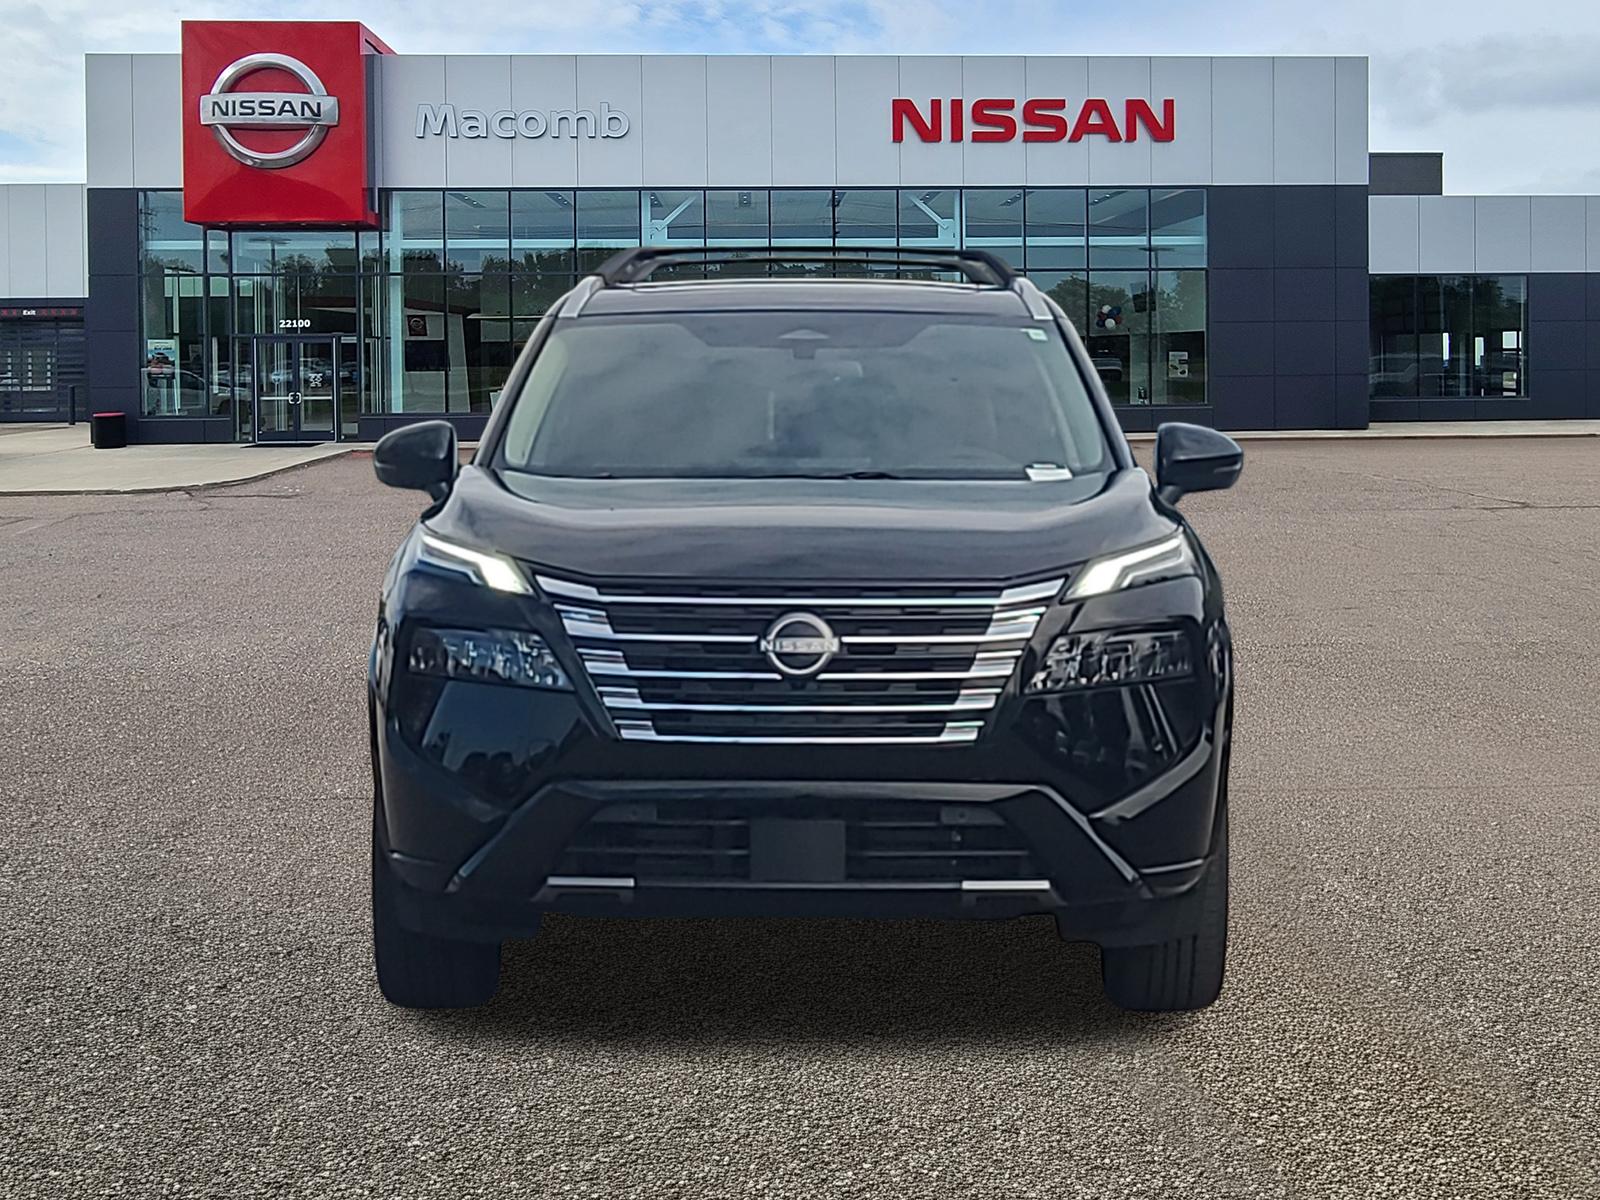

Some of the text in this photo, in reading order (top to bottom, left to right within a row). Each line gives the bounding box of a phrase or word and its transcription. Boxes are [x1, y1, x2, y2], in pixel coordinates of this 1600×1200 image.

[211, 100, 322, 118] NISSAN
[415, 102, 630, 139] Macomb
[892, 98, 1175, 143] NISSAN
[279, 319, 311, 328] 22100
[760, 639, 838, 652] NISSAN
